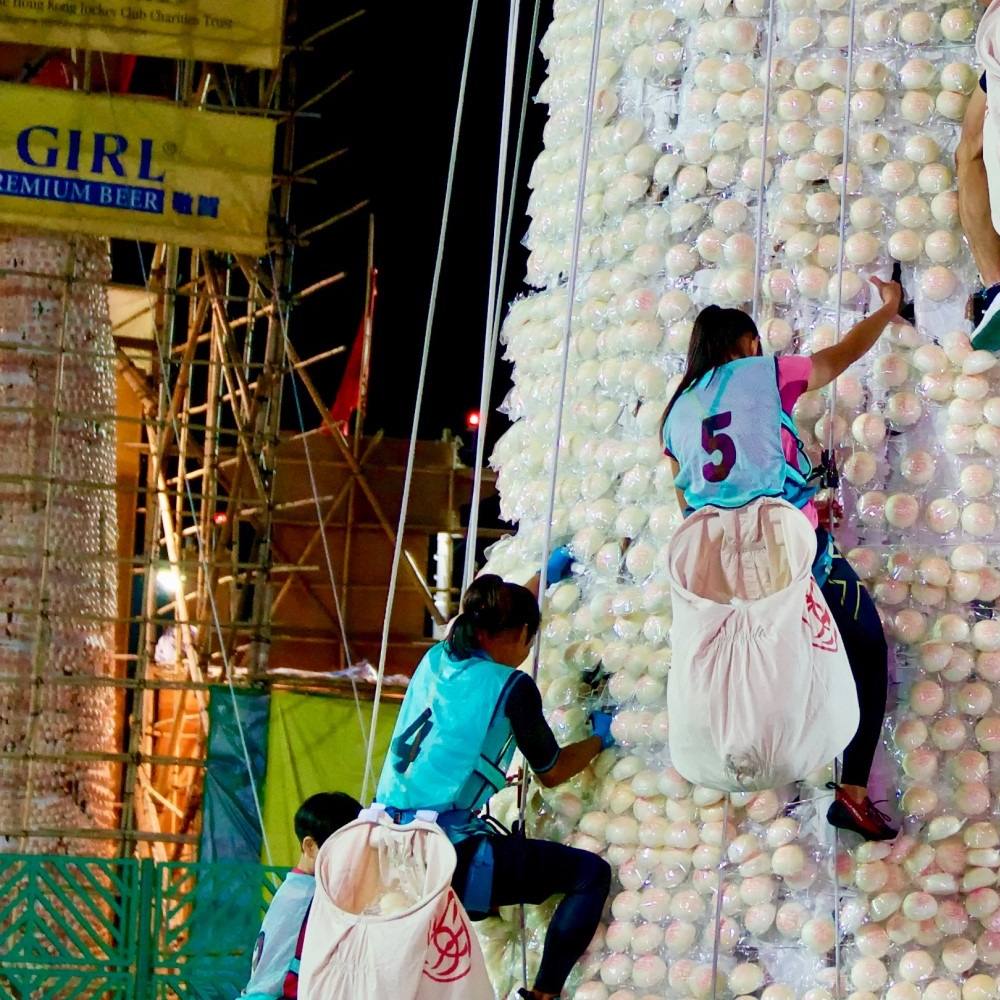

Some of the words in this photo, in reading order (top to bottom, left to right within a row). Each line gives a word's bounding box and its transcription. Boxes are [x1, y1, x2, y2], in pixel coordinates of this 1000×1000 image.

[47, 0, 76, 15] Kong
[120, 6, 147, 21] Club
[204, 14, 233, 29] Trust
[100, 186, 158, 211] BEER
[702, 411, 736, 482] 5
[391, 707, 434, 774] 4
